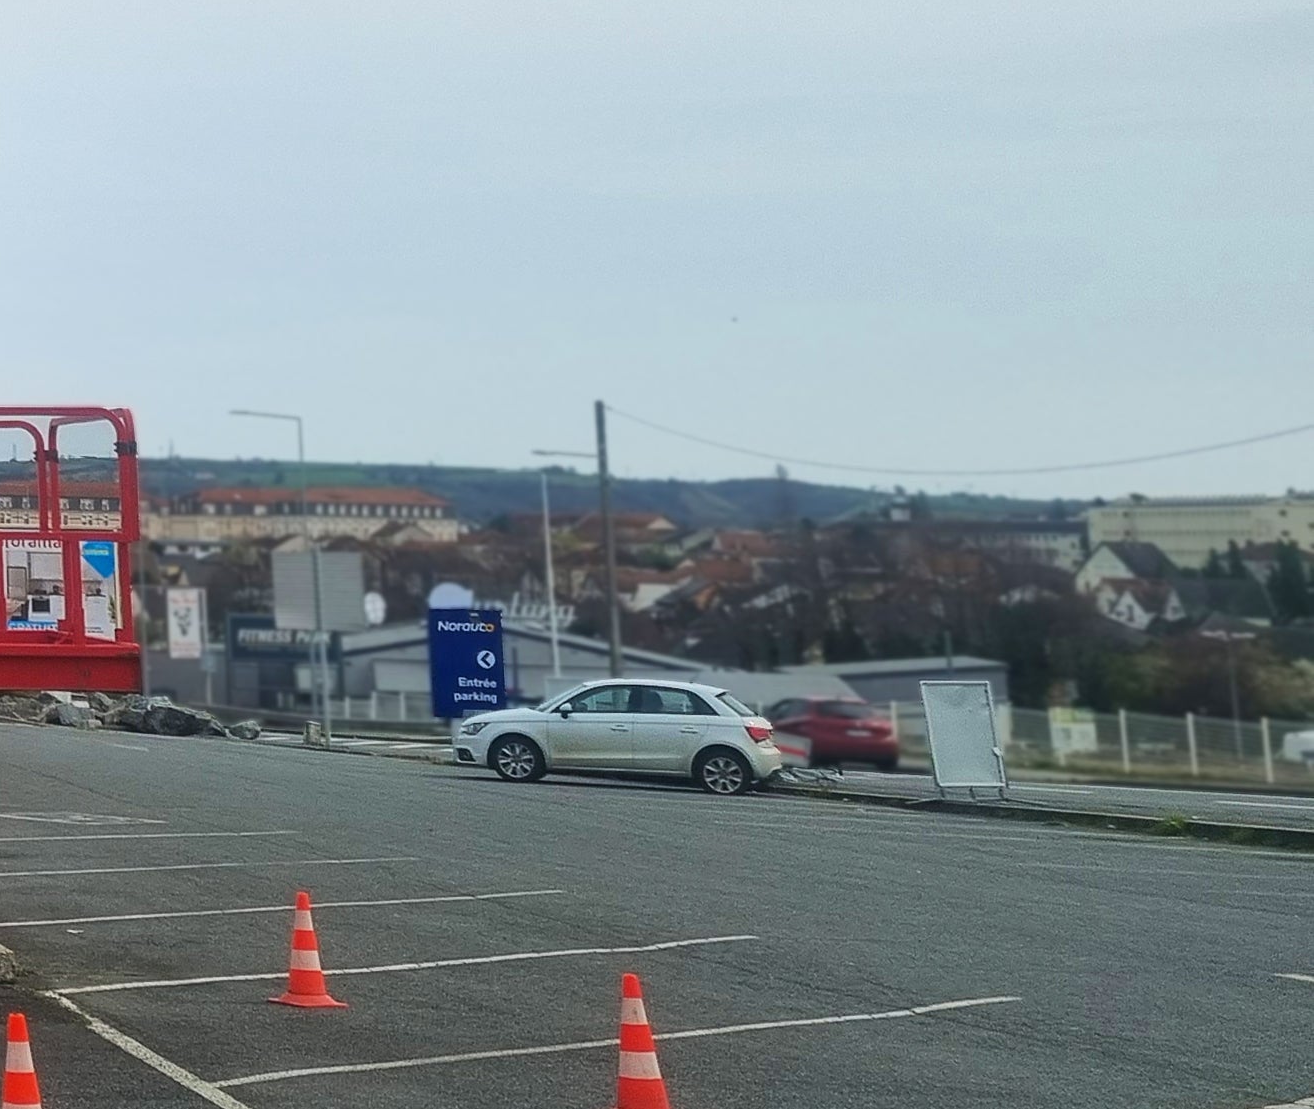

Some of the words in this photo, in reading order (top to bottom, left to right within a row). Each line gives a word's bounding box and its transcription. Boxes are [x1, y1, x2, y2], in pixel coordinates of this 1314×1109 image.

[437, 620, 495, 633] Norauto
[458, 676, 498, 689] Entrée
[453, 693, 498, 704] parking
